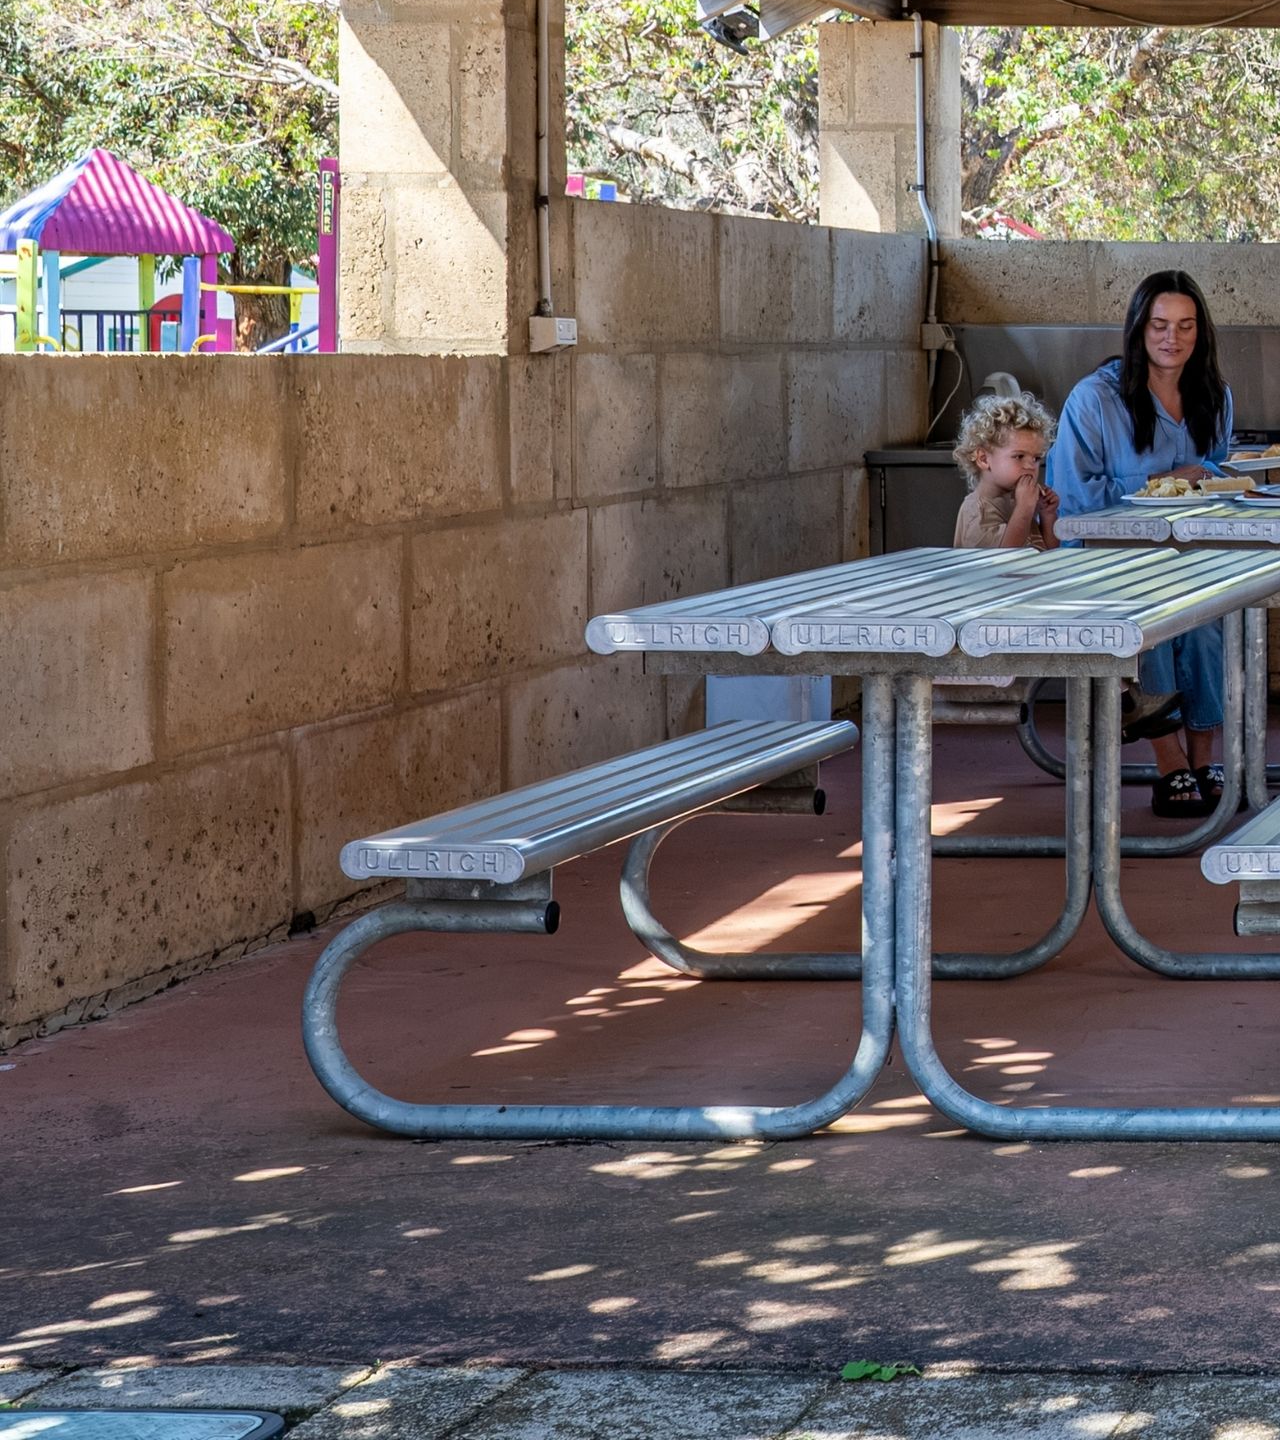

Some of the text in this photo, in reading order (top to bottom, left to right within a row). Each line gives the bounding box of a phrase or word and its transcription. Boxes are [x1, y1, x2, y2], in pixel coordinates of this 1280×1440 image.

[324, 172, 332, 233] FORPARK
[1071, 520, 1160, 537] ULLRICH
[1186, 520, 1274, 537] ULLRICH
[607, 622, 745, 646] ULLRICH
[799, 624, 930, 646] ULLRICH
[983, 624, 1117, 647] ULLRICH
[364, 849, 498, 873] ULLRICH
